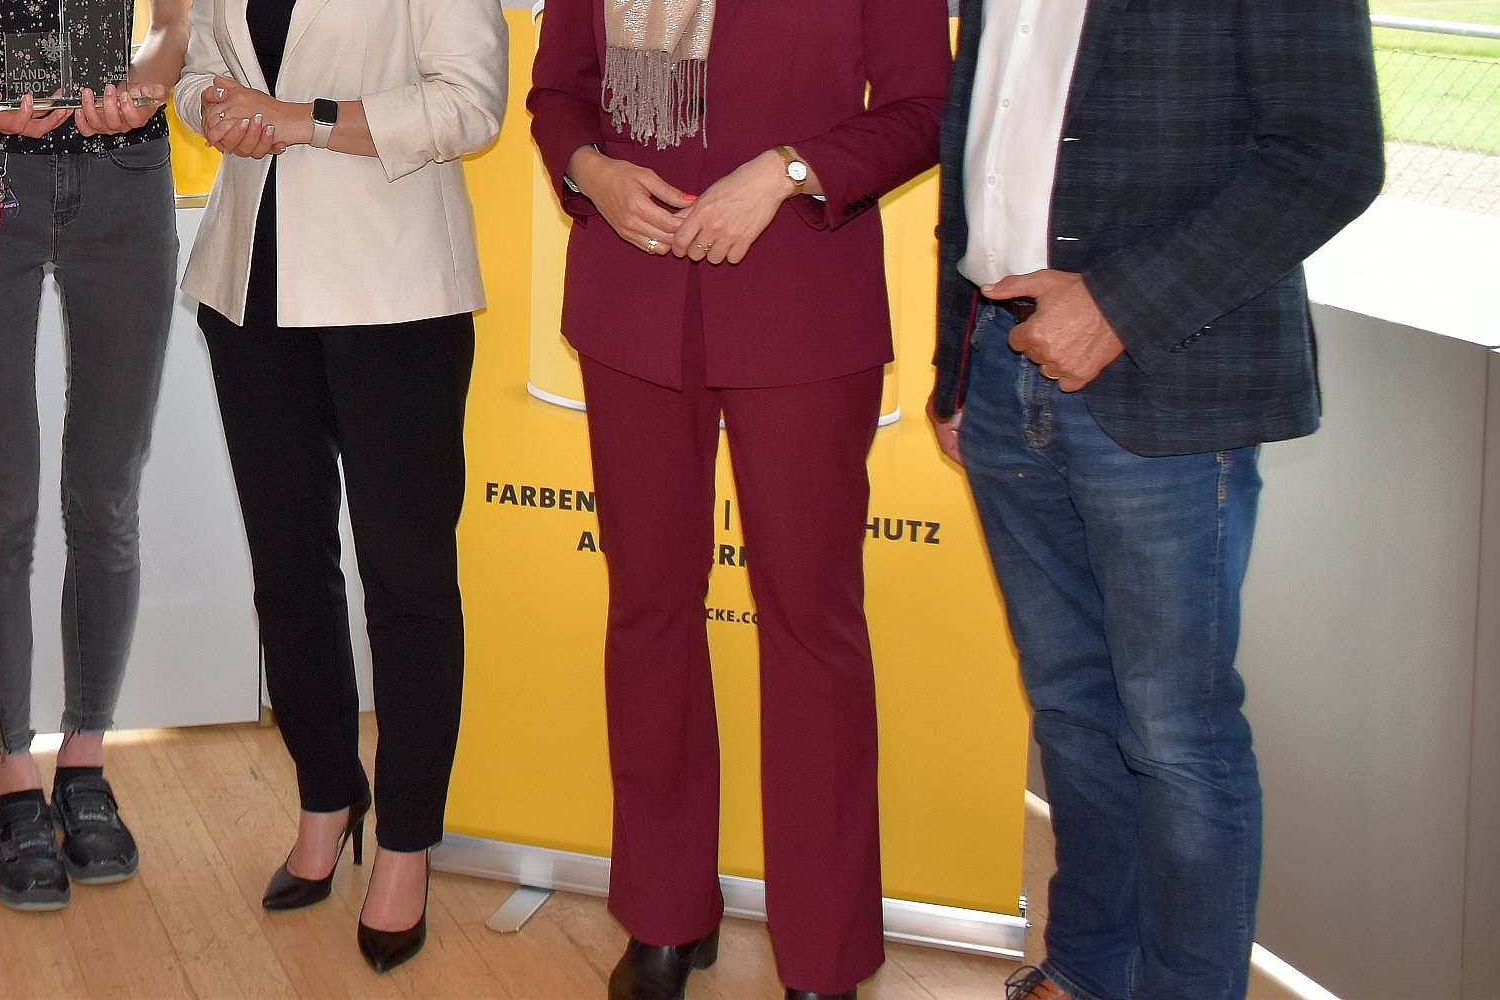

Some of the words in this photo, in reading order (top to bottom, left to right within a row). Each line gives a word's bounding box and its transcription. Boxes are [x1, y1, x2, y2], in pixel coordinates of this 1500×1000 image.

[12, 68, 47, 81] LAND
[110, 73, 127, 81] 2025
[12, 81, 50, 93] TIROL
[485, 482, 596, 513] FARBEN
[866, 516, 941, 545] HUTZ
